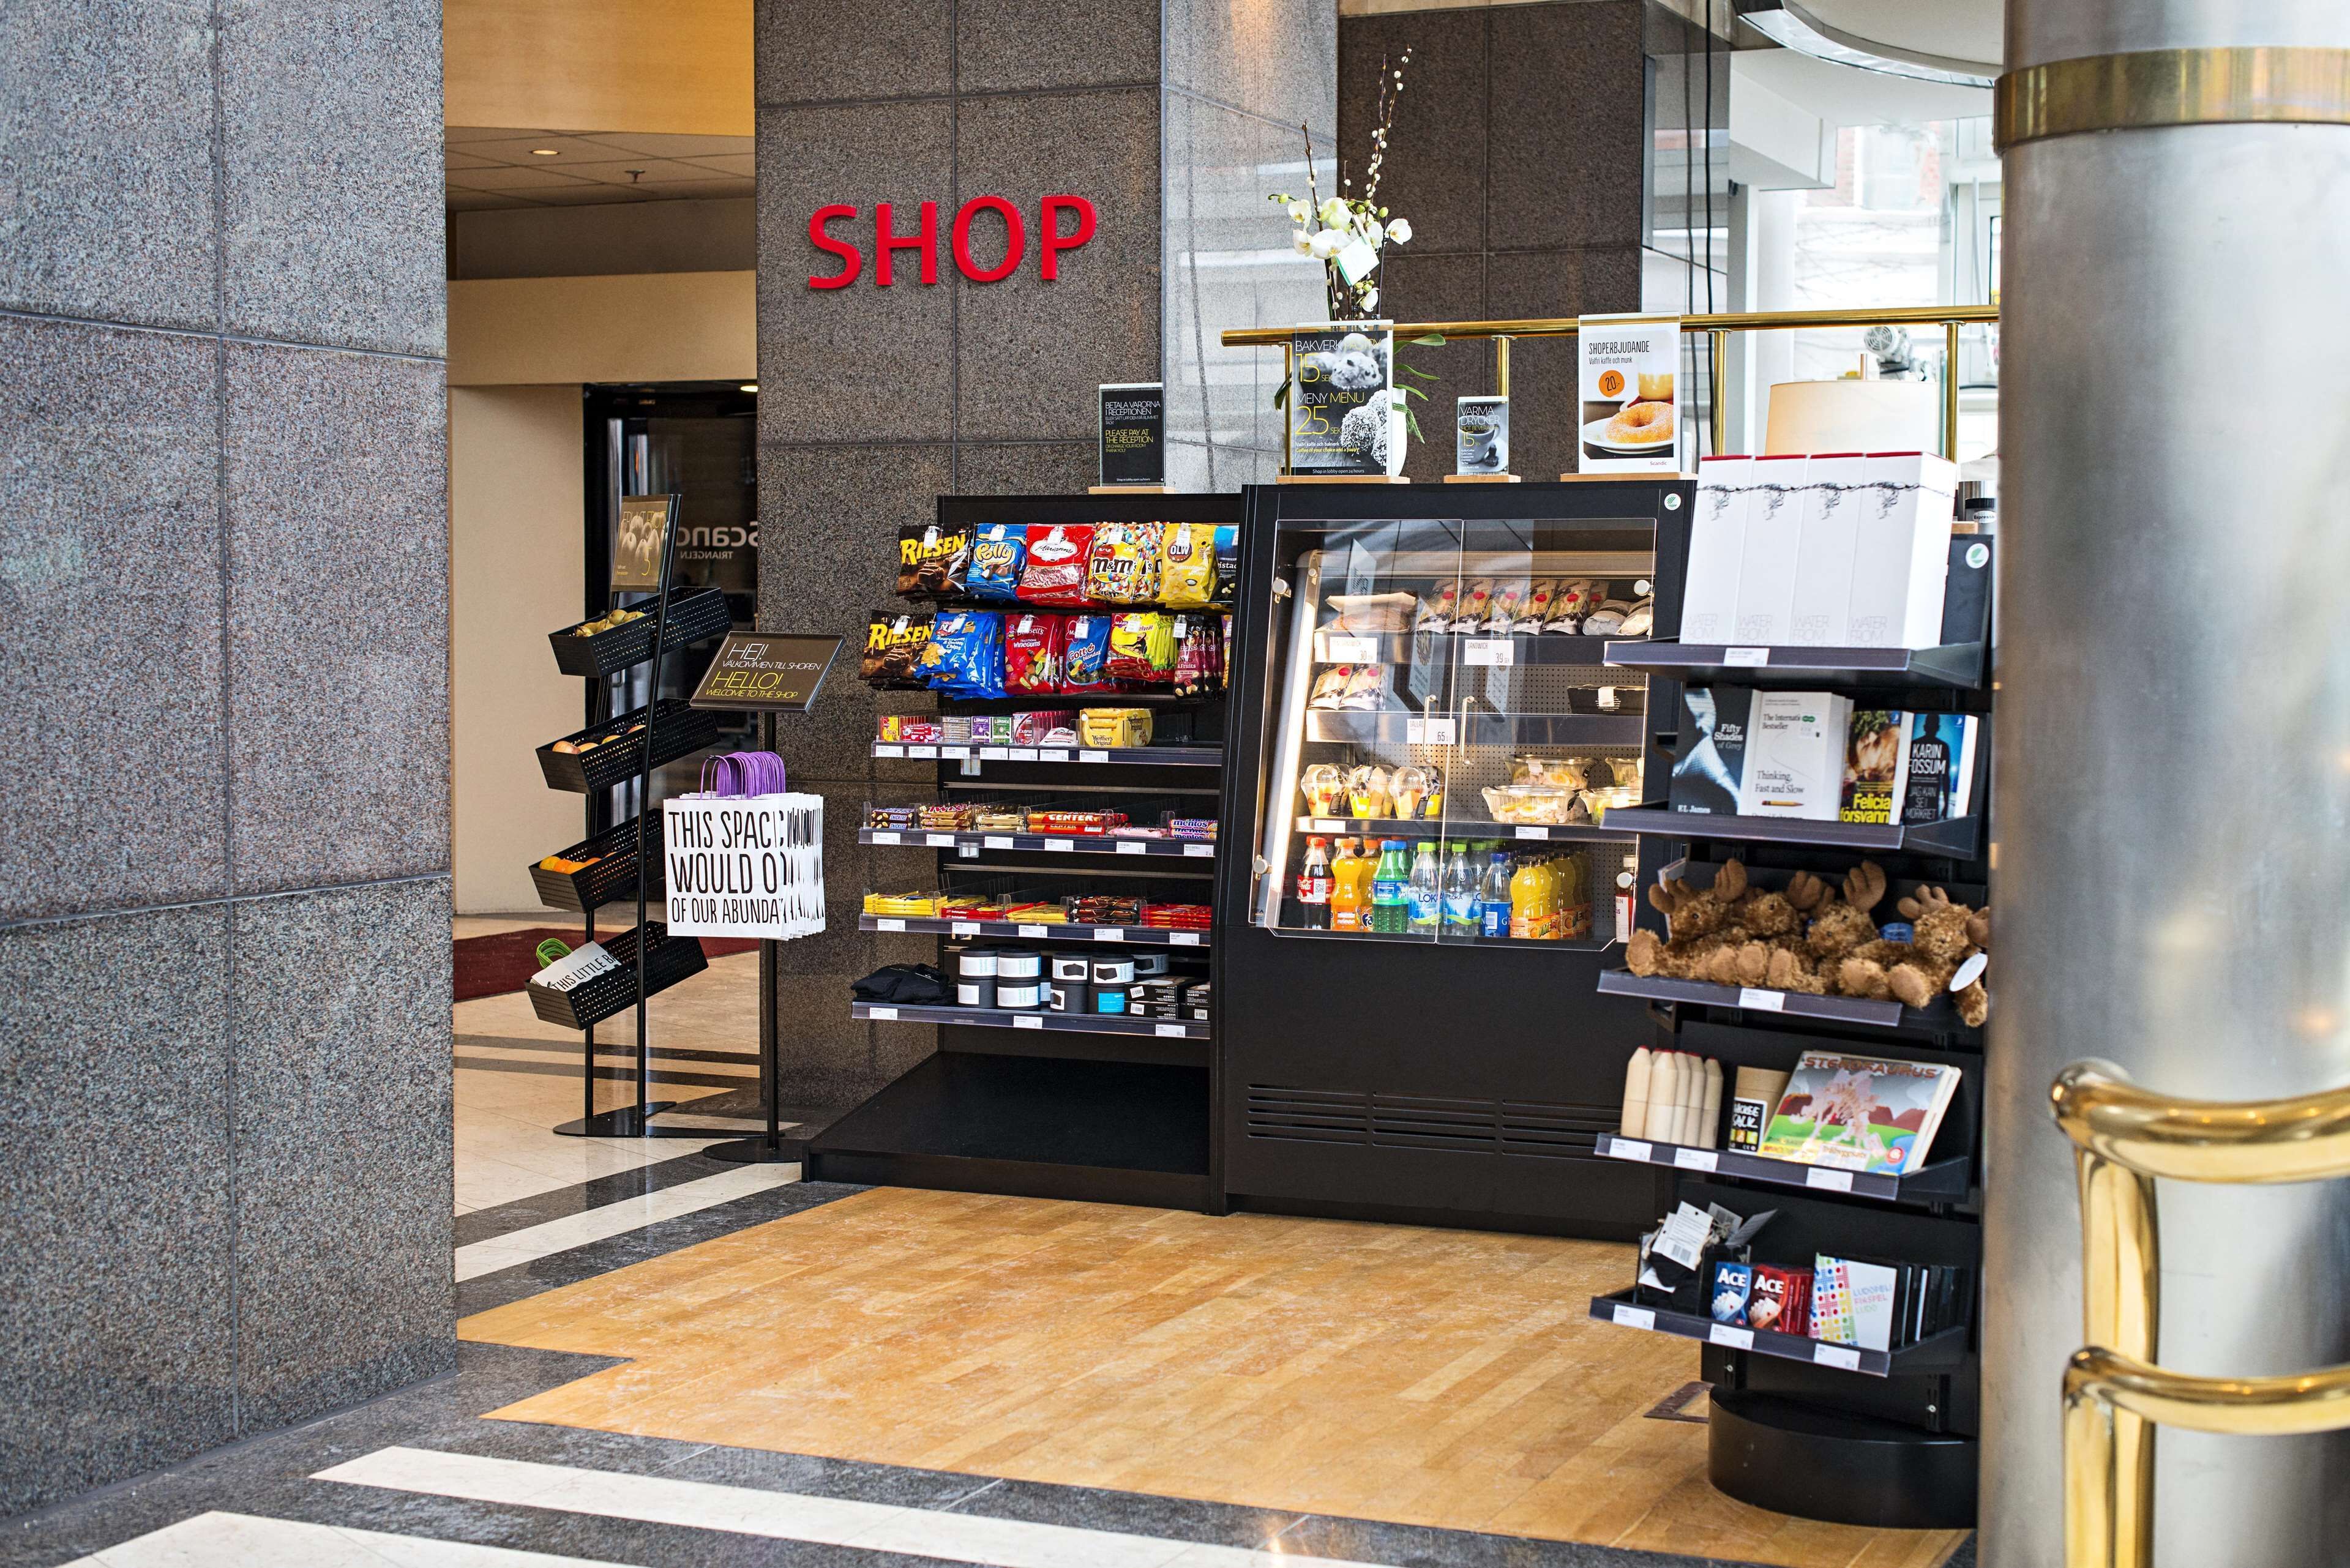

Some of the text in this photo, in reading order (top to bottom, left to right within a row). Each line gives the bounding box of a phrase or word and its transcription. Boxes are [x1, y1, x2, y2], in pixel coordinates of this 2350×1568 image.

[809, 195, 1097, 289] SHOP
[1295, 339, 1342, 352] BAKVERK
[1588, 340, 1650, 354] SHOPERBJUDANDE
[1295, 353, 1320, 383] 15
[1296, 392, 1364, 404] MENY MENU
[1460, 406, 1494, 416] VARMA
[1295, 405, 1329, 435] 25
[1461, 415, 1500, 425] DRYCKER
[1462, 431, 1475, 447] 15
[976, 542, 1012, 562] Polly
[1170, 545, 1189, 555] OLW
[727, 643, 769, 662] HEJ!
[1068, 649, 1087, 662] Gott
[1082, 651, 1101, 662] blandat
[1360, 650, 1367, 660] 30
[1495, 652, 1503, 663] 39
[722, 659, 774, 669] VÄLKOMMEN
[711, 671, 784, 690] HELLO!
[706, 689, 746, 697] WELCOME
[1721, 724, 1742, 733] Fifty
[1437, 731, 1445, 741] 65
[1714, 733, 1743, 741] Shades
[1726, 742, 1742, 751] Grey
[1912, 744, 1942, 758] KARIN
[1909, 758, 1947, 774] FOSSUM
[1757, 771, 1792, 783] Thinking,
[1755, 784, 1805, 794] Fast and Slow
[1853, 793, 1892, 810] Felicia
[1690, 805, 1711, 814] James
[1839, 807, 1890, 823] försvann
[668, 810, 777, 849] THIS SPAC
[670, 853, 753, 894] WOULD
[672, 897, 780, 924] OF OUR ABUNDA
[551, 958, 607, 992] THIS LITTLE
[1717, 1267, 1747, 1288] ACE
[1754, 1274, 1785, 1294] ACE
